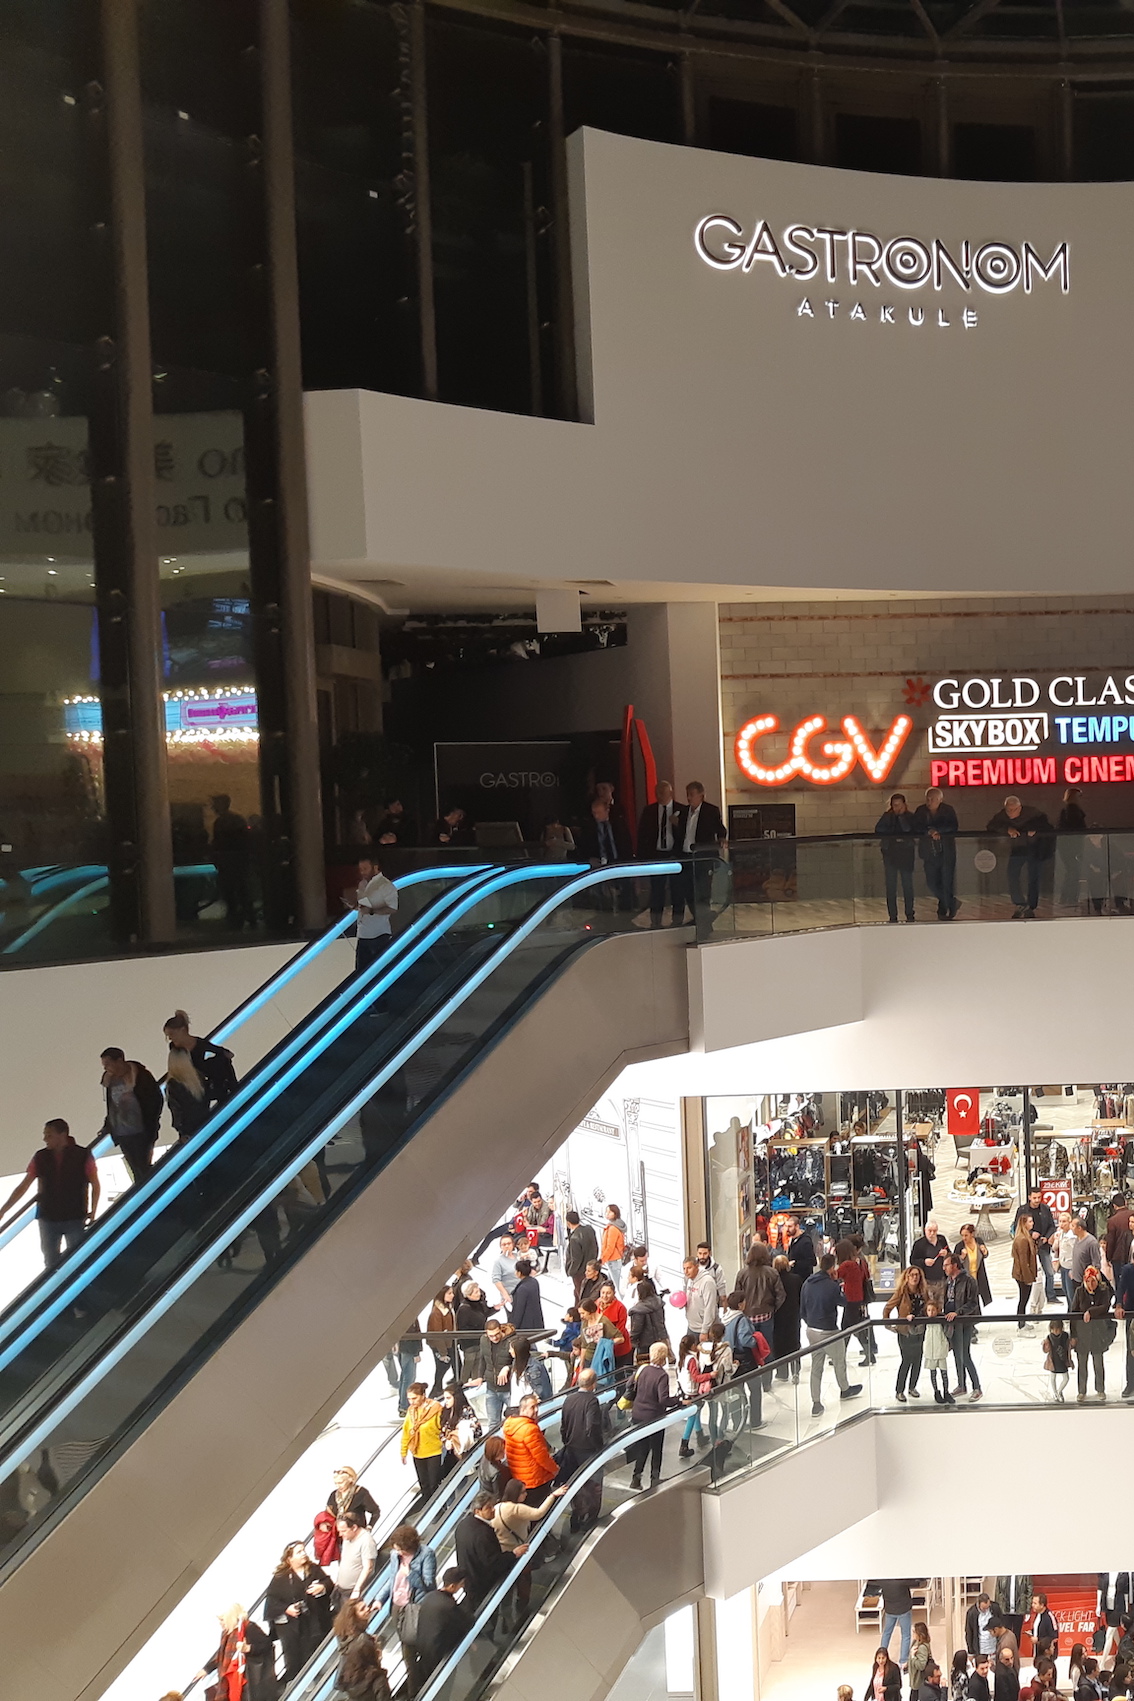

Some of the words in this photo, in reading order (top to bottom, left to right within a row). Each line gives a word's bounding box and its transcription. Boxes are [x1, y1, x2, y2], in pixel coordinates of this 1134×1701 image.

[694, 212, 1071, 294] GASTRONOM
[797, 296, 979, 329] ATAKULE
[932, 678, 1041, 710] GOLD
[934, 718, 1042, 748] SKYBOX
[734, 712, 914, 787] CGV
[479, 771, 560, 789] GASTRO
[931, 757, 1057, 787] PREMIUM
[1042, 1190, 1070, 1212] 20
[1059, 1621, 1075, 1633] VEL
[1077, 1621, 1096, 1633] FAR
[1067, 1610, 1094, 1622] LIGHT
